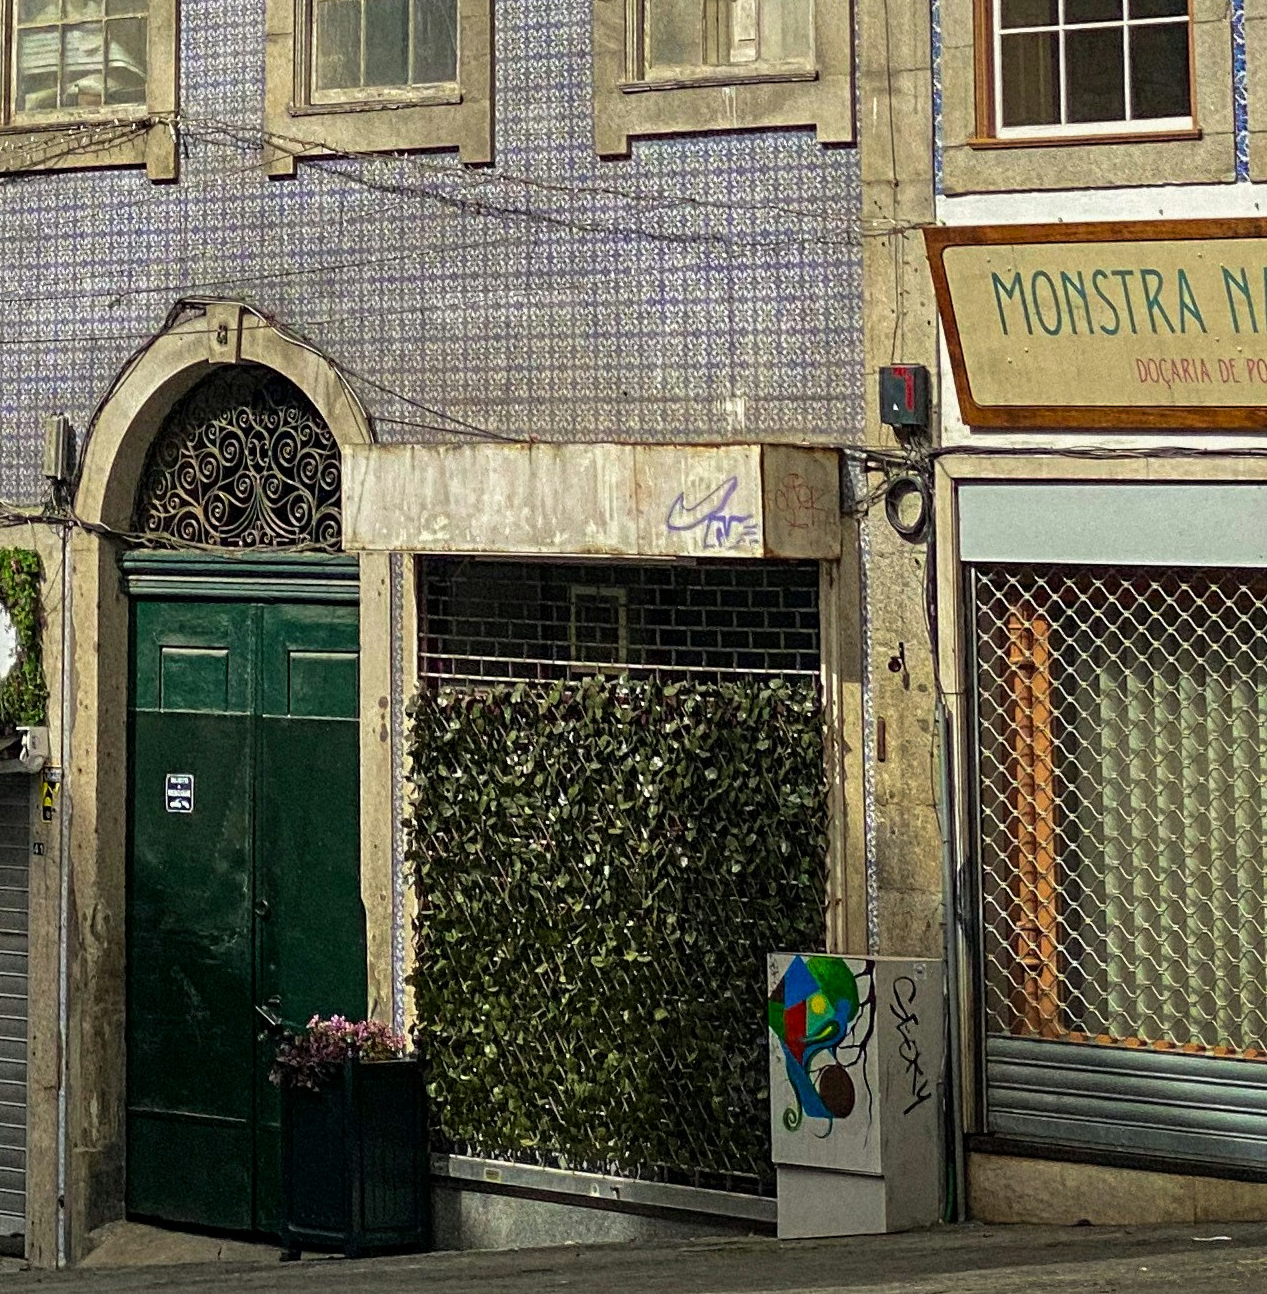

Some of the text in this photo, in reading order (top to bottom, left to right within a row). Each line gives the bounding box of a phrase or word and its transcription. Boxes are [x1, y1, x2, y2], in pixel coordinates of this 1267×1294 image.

[990, 265, 1267, 336] MONSTRA N
[1136, 357, 1212, 388] DOÇARIA
[1218, 357, 1241, 383] DE
